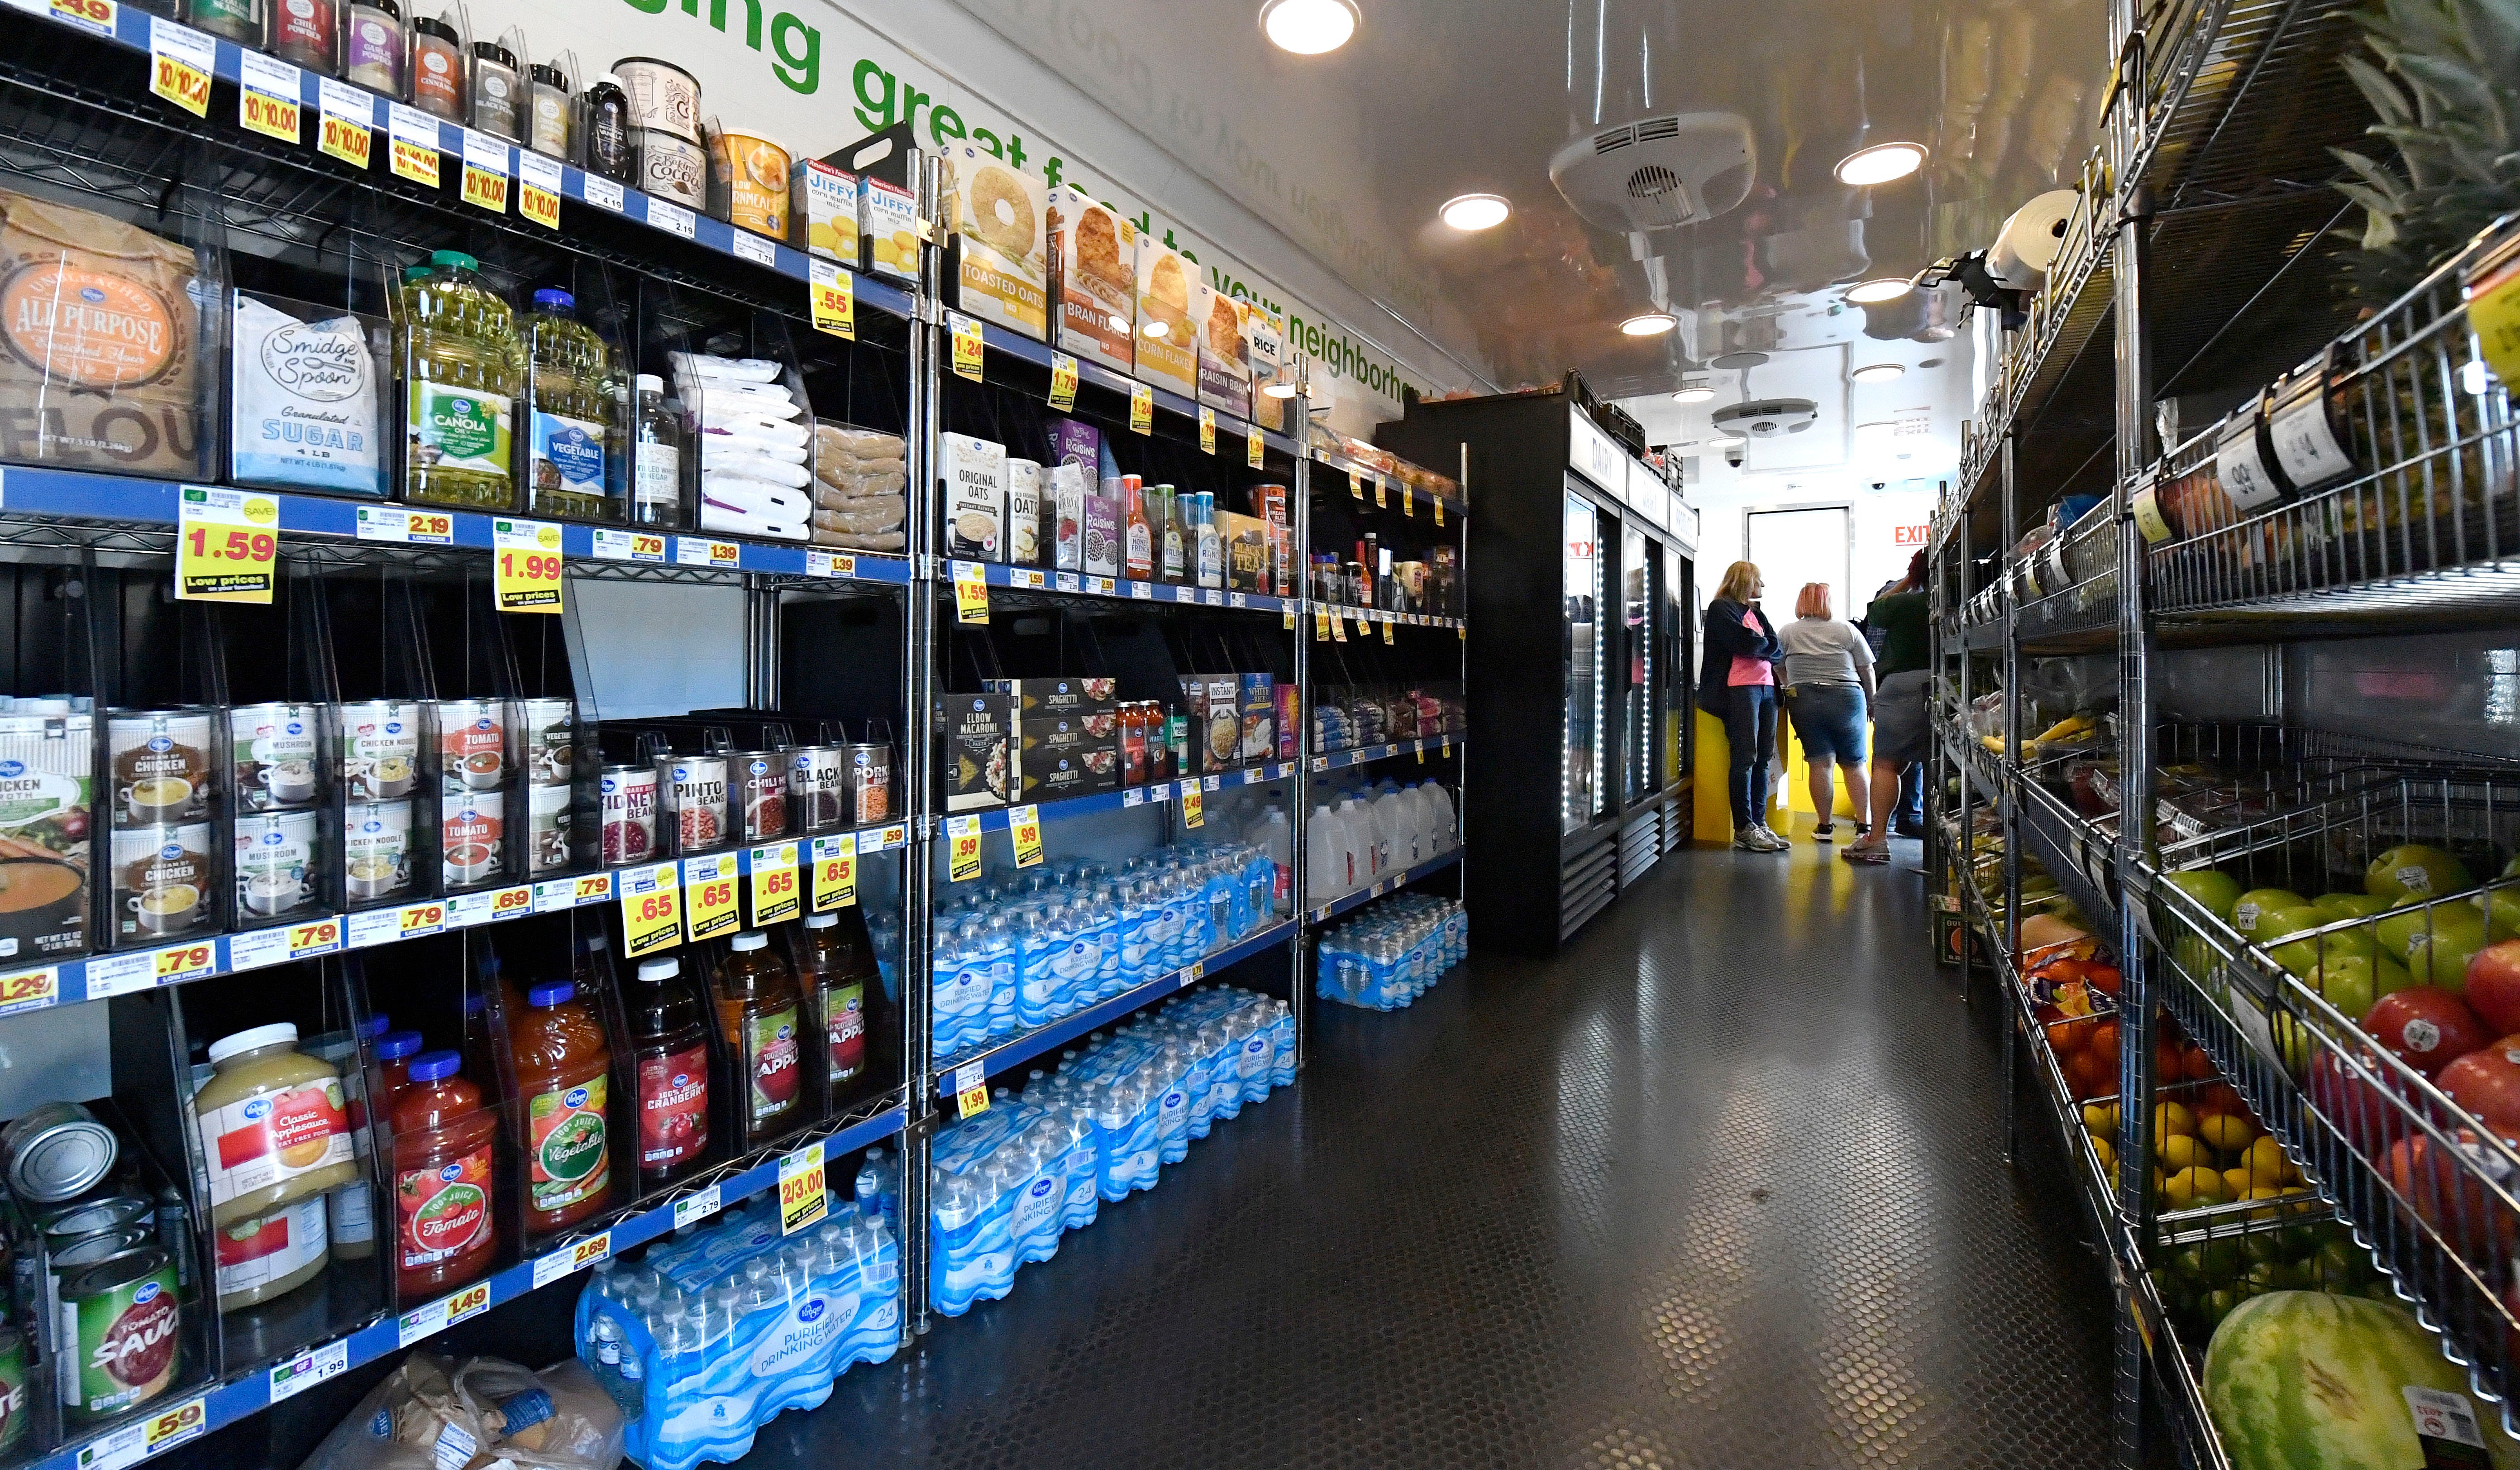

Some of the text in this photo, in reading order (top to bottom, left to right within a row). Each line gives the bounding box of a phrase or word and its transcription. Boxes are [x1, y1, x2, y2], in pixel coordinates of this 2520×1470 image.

[245, 97, 296, 132] 10/10.00
[325, 121, 368, 157] 10/10.00
[808, 159, 855, 182] America's Favorite
[466, 173, 504, 202] 10/10.00
[810, 174, 854, 200] JIFFY
[523, 189, 557, 220] 10/10.00
[603, 197, 621, 208] 4.19
[811, 188, 854, 208] corn muffin
[826, 200, 840, 209] mix
[871, 191, 912, 215] JIFFY
[873, 205, 912, 223] corn muffin
[888, 215, 900, 225] mix
[676, 222, 693, 235] 2.19
[758, 253, 773, 263] 1.79
[964, 264, 1043, 308] TOASTED OATS
[820, 292, 847, 312] .55
[1006, 302, 1017, 313] NO
[1068, 302, 1096, 325] BRAN
[16, 298, 61, 332] ALL
[65, 305, 162, 354] PURPOSE
[272, 331, 358, 357] Smidge
[955, 336, 982, 359] 1.24
[1254, 336, 1275, 356] RICE
[1137, 338, 1193, 372] CORN FLAKES
[1290, 314, 1432, 403] neighborh
[278, 357, 352, 386] Spoon
[1055, 371, 1077, 391] 1.79
[1201, 369, 1247, 396] RAISIN BRAN
[1133, 398, 1151, 416] 1.24
[282, 407, 348, 426] Granulated
[434, 414, 487, 432] CANOLA
[262, 419, 363, 452] SUGAR
[552, 441, 599, 460] VEGETABLE
[1250, 440, 1263, 453] 1.24
[1592, 437, 1612, 481] DAIRY
[959, 469, 998, 488] ORIGINAL
[968, 485, 988, 500] OATS
[1014, 498, 1038, 514] OATS
[410, 516, 449, 534] 2.19
[189, 528, 274, 562] 1.59
[634, 537, 662, 552] .79
[711, 545, 737, 560] 1.39
[1234, 543, 1261, 557] BLACK
[501, 554, 560, 579] 1.99
[832, 558, 853, 571] 1.39
[1234, 556, 1260, 572] TEA
[187, 574, 264, 587] Low prices
[1029, 574, 1043, 584] 1.59
[1102, 580, 1113, 589] 2.59
[502, 590, 555, 602] Low prices
[958, 584, 987, 601] 1.59
[1048, 694, 1077, 704] SPAGHETTI
[1211, 686, 1235, 695] INSTANT
[967, 712, 991, 723] ELBOW
[960, 723, 997, 734] MACARONI
[272, 741, 311, 749] MUSHROOM
[465, 733, 499, 744] TOMATO
[1049, 733, 1078, 743] SPAGHETTI
[135, 760, 186, 772] CHICKEN
[797, 767, 840, 782] BLACK
[854, 765, 889, 778] PORK
[747, 779, 779, 789] CHILI
[1049, 771, 1078, 782] SPAGHETTI
[626, 785, 644, 795] DARK
[674, 780, 722, 798] PINTO
[697, 794, 724, 805] BEANS
[1184, 796, 1201, 810] 2.49
[376, 834, 402, 843] NOODLE
[448, 824, 487, 837] TOMATO
[883, 829, 902, 842] .59
[1020, 827, 1036, 843] .99
[957, 838, 976, 856] .99
[144, 866, 195, 881] CHICKEN
[822, 861, 850, 883] .65
[577, 877, 608, 897] .79
[763, 872, 792, 895] .65
[494, 890, 529, 909] .69
[697, 883, 731, 908] .65
[402, 907, 441, 928] .79
[636, 895, 673, 923] .65
[693, 912, 734, 932] Low prices
[292, 924, 336, 948] .79
[631, 924, 675, 949] Low prices
[159, 947, 209, 973] .79
[1110, 958, 1117, 969] 12
[954, 984, 981, 998] PURIFIED
[1002, 990, 1011, 1001] 12
[1280, 1055, 1291, 1065] 24
[974, 1073, 983, 1082] 2.49
[681, 1081, 699, 1093] JUICE
[647, 1084, 705, 1110] CRANBERRY
[964, 1091, 984, 1110] 1.99
[1198, 1101, 1208, 1111] 24
[280, 1111, 318, 1126] Classic
[574, 1117, 595, 1127] JUICE
[270, 1118, 330, 1140] Applesauce
[294, 1129, 330, 1144] FREE FOOD
[548, 1134, 603, 1162] Vegetable
[783, 1170, 822, 1204] 2/3.00
[1079, 1186, 1092, 1198] 24
[450, 1191, 473, 1202] JUICE
[702, 1201, 718, 1213] 2.79
[423, 1208, 479, 1237] Tomato
[576, 1237, 607, 1261] 2.69
[449, 1288, 486, 1315] 1.49
[802, 1300, 824, 1322] Kroger
[877, 1305, 894, 1323] 24
[784, 1313, 835, 1345] PURIFIED
[761, 1308, 851, 1372] DRINKING WATER
[295, 1359, 310, 1371] GF
[318, 1360, 344, 1378] 1.99
[150, 1405, 200, 1441] .59
